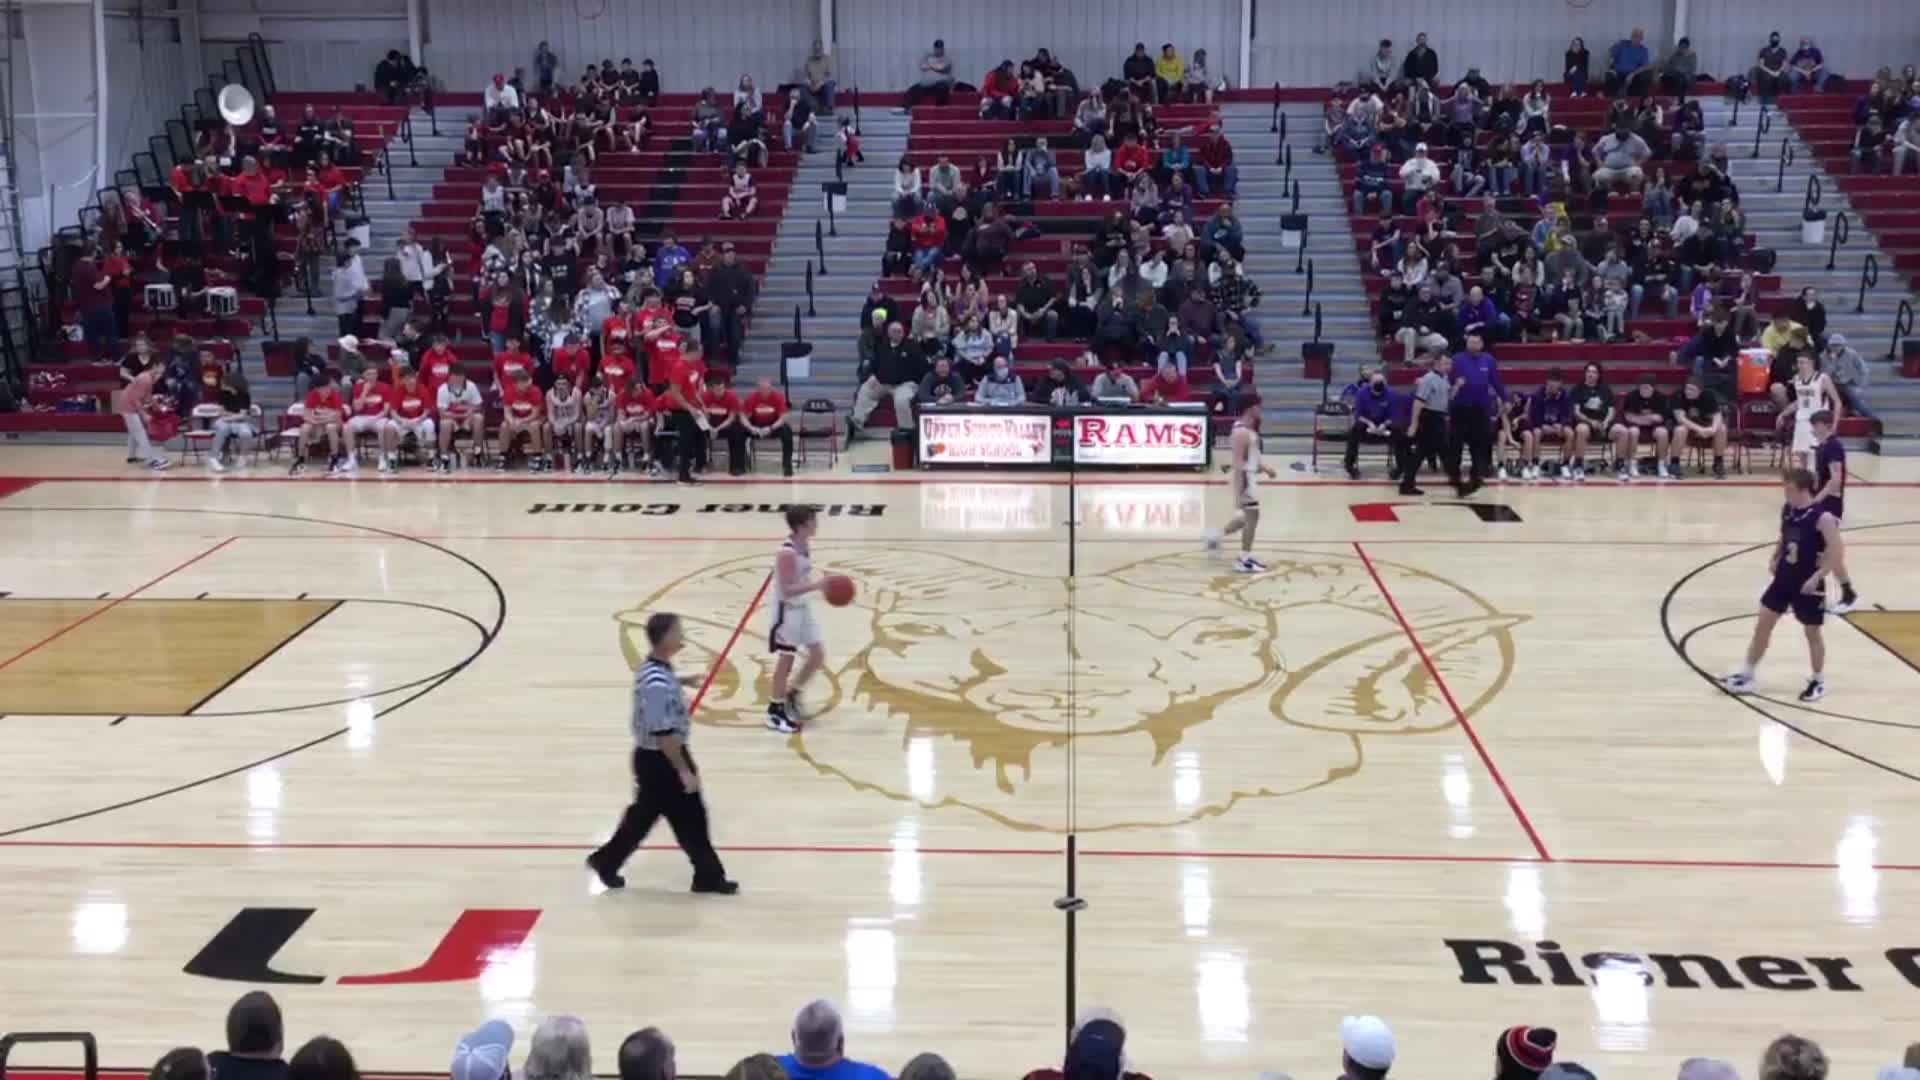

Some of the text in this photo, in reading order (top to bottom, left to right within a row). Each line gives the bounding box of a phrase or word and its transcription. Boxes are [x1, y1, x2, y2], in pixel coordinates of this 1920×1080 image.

[1078, 418, 1203, 448] RAMS
[526, 503, 681, 517] Court
[1785, 541, 1799, 565] 3
[1443, 938, 1864, 992] Risner
